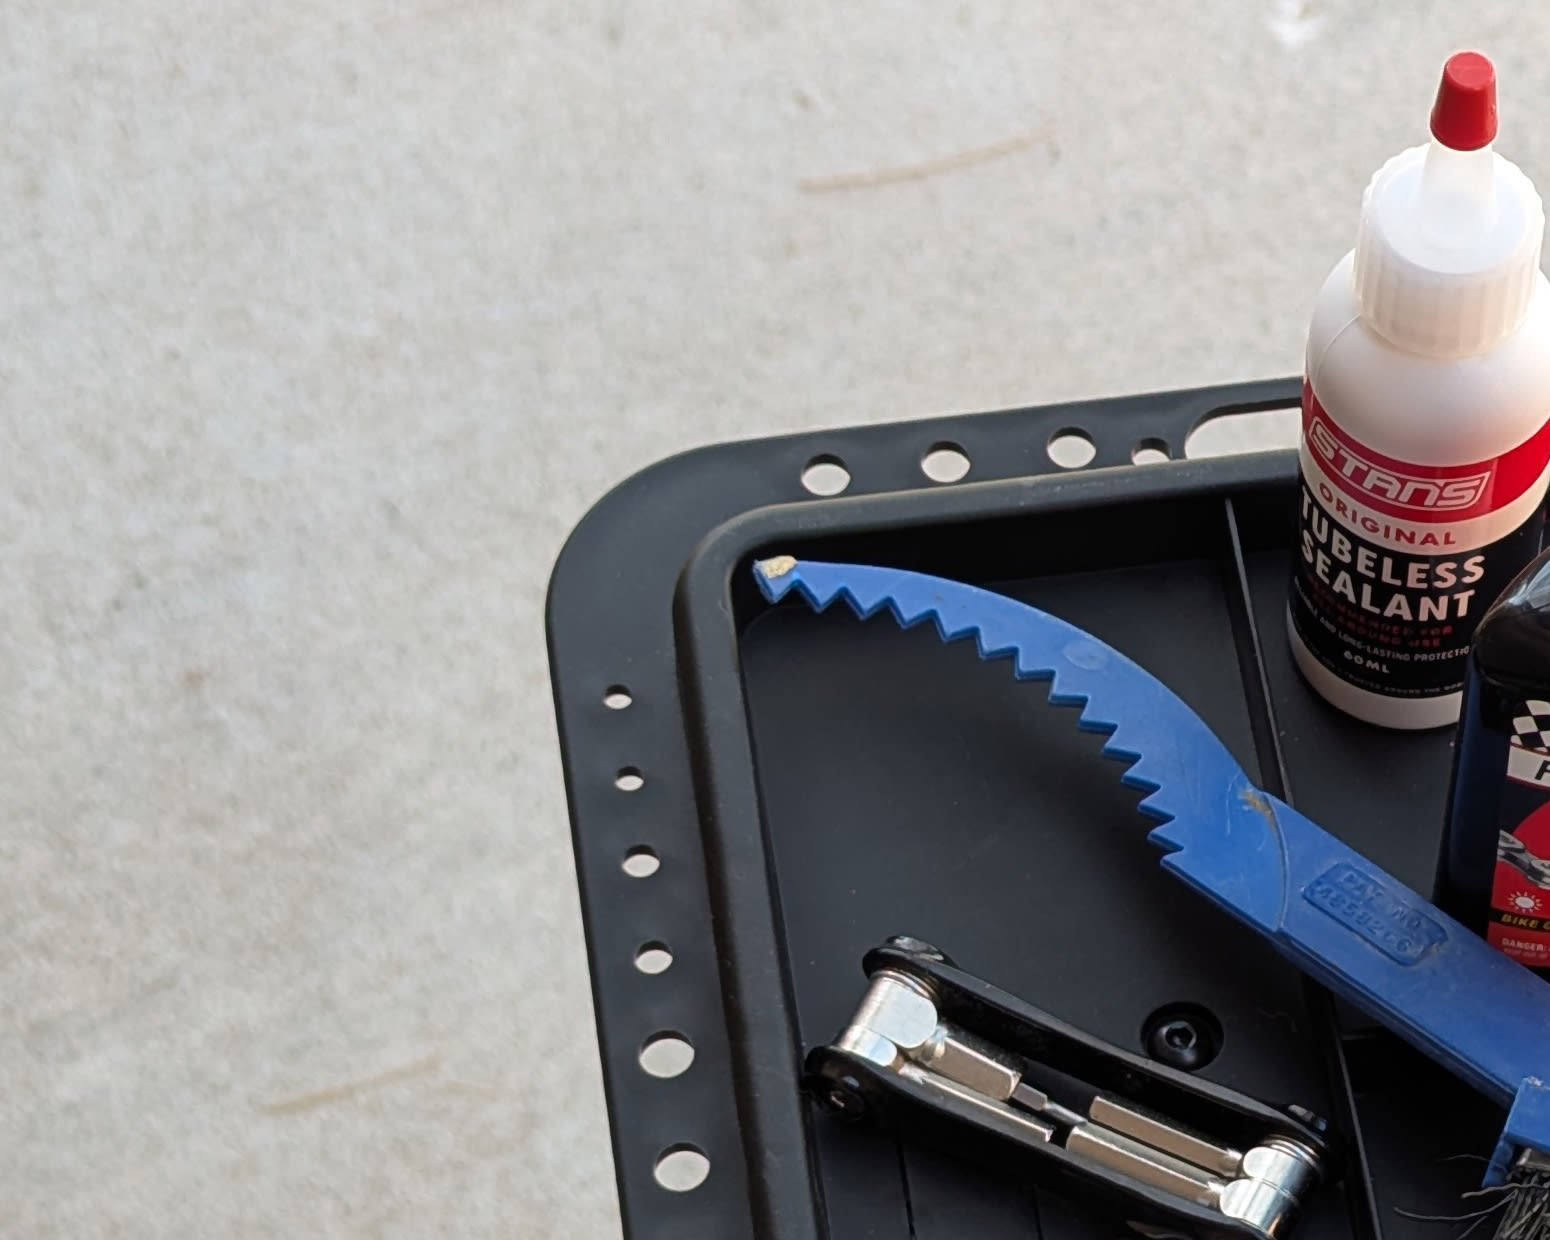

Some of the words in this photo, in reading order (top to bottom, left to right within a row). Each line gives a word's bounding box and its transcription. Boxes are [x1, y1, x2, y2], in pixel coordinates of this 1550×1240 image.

[1302, 485, 1486, 589] TUBELESS
[1320, 482, 1456, 546] ORIGINAL
[1302, 529, 1475, 622] SEALANT
[1413, 645, 1471, 663] PROTECTIO
[1501, 913, 1539, 928] BIKE
